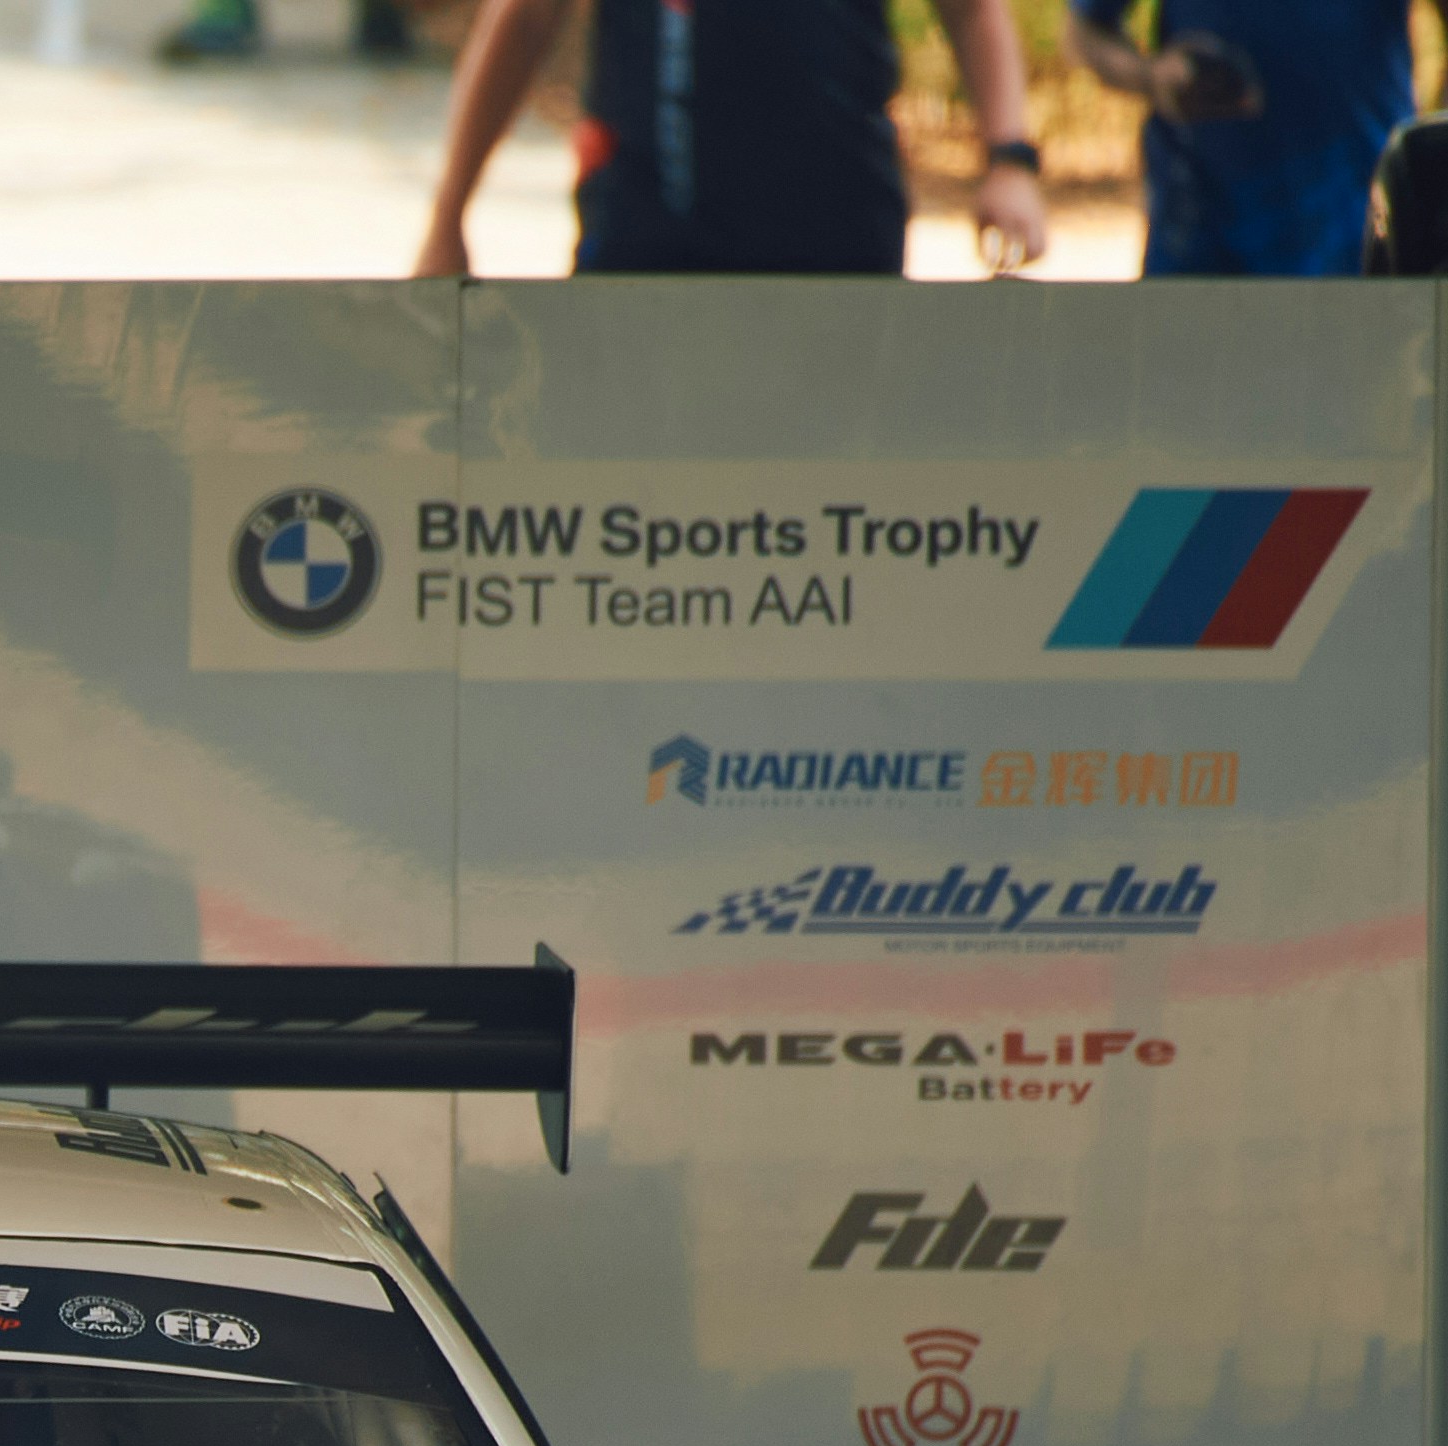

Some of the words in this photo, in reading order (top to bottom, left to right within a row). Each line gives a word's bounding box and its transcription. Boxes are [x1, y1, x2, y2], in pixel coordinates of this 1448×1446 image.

[417, 503, 583, 557] BMW
[600, 506, 807, 567] Sports
[822, 506, 1040, 567] Trophy
[416, 571, 555, 627] FIST
[574, 574, 733, 628] Team
[748, 575, 854, 628] AAI
[715, 750, 967, 792] RADIANCE
[976, 750, 1240, 808] 金辉集团
[809, 864, 1054, 932] Buddy
[1057, 864, 1219, 919] club
[917, 1075, 1093, 1105] Battery
